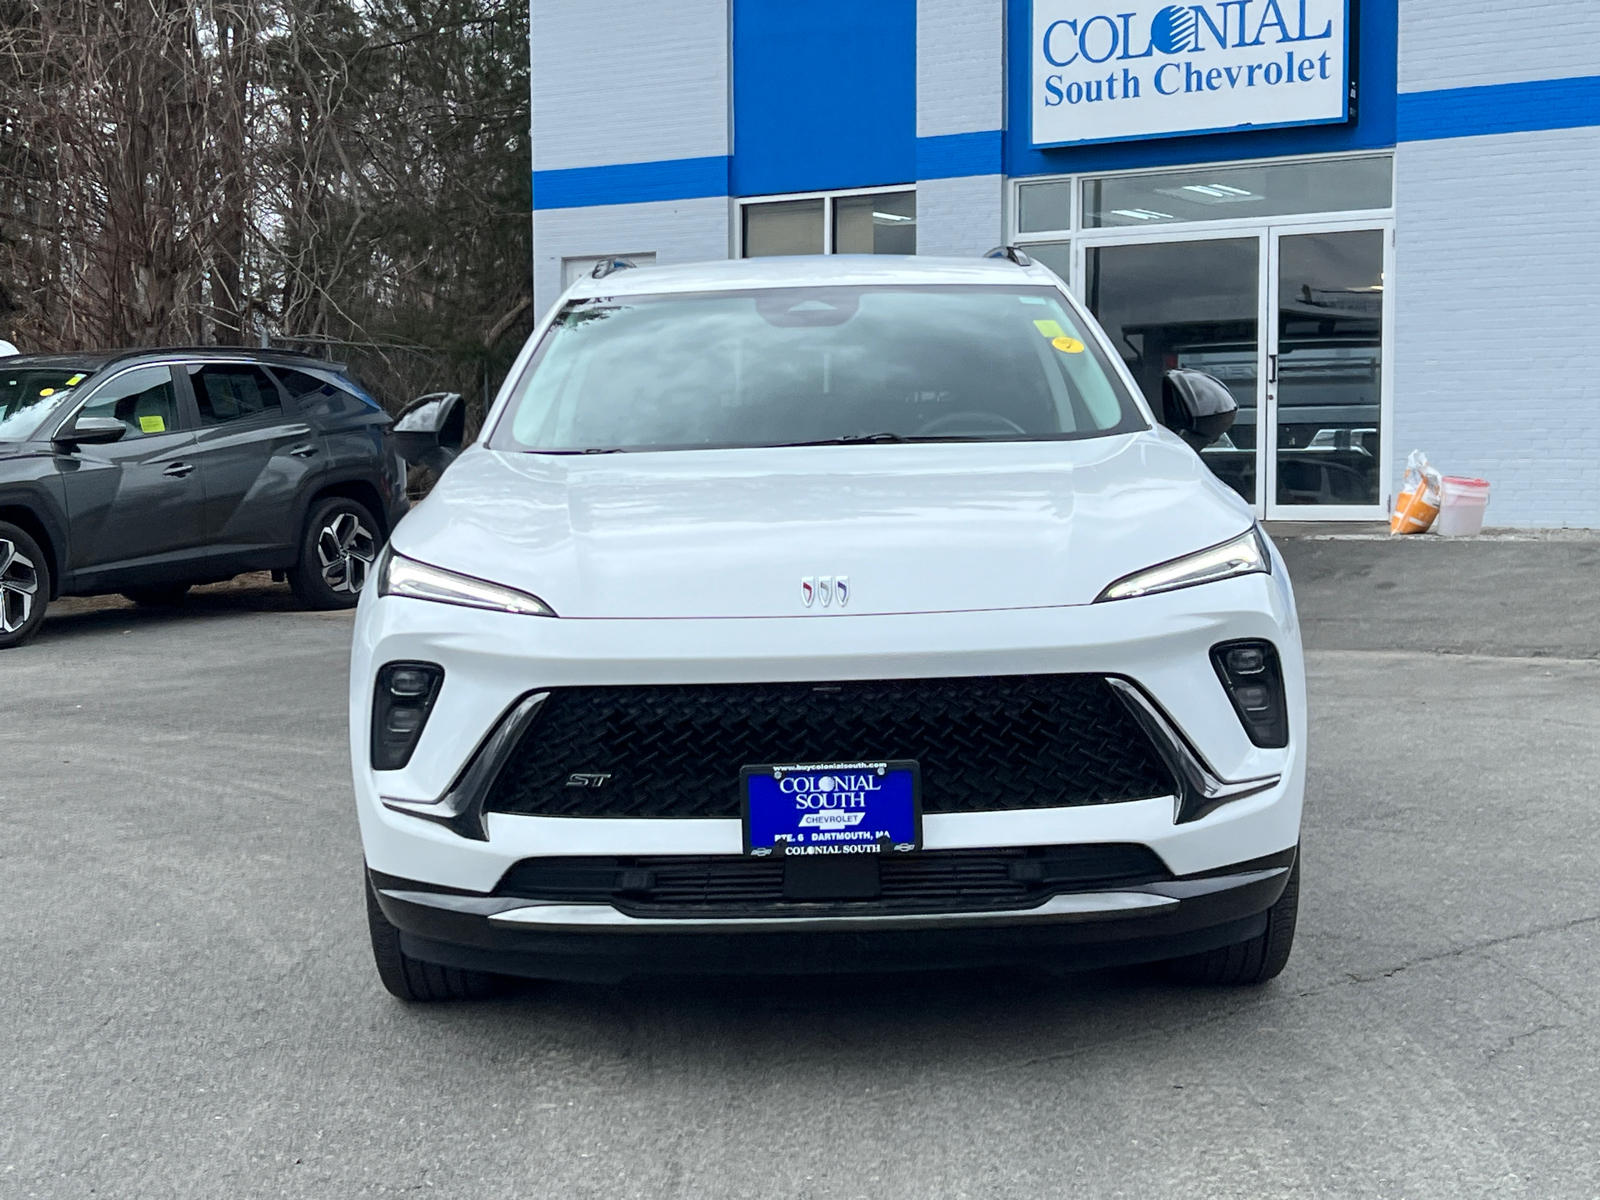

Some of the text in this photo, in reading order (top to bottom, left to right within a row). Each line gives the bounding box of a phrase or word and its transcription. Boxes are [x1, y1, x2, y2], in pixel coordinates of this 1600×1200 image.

[1042, 0, 1332, 68] COLONIAL
[1045, 50, 1332, 107] South Chevrolet
[565, 773, 612, 787] ST
[779, 775, 882, 794] COLONIAL
[796, 791, 866, 809] SOUTH
[805, 815, 859, 824] CHEVROLET
[797, 833, 805, 842] 6
[811, 831, 874, 841] DARTMOUTH,
[785, 844, 881, 855] COLONIAL SOUTH
